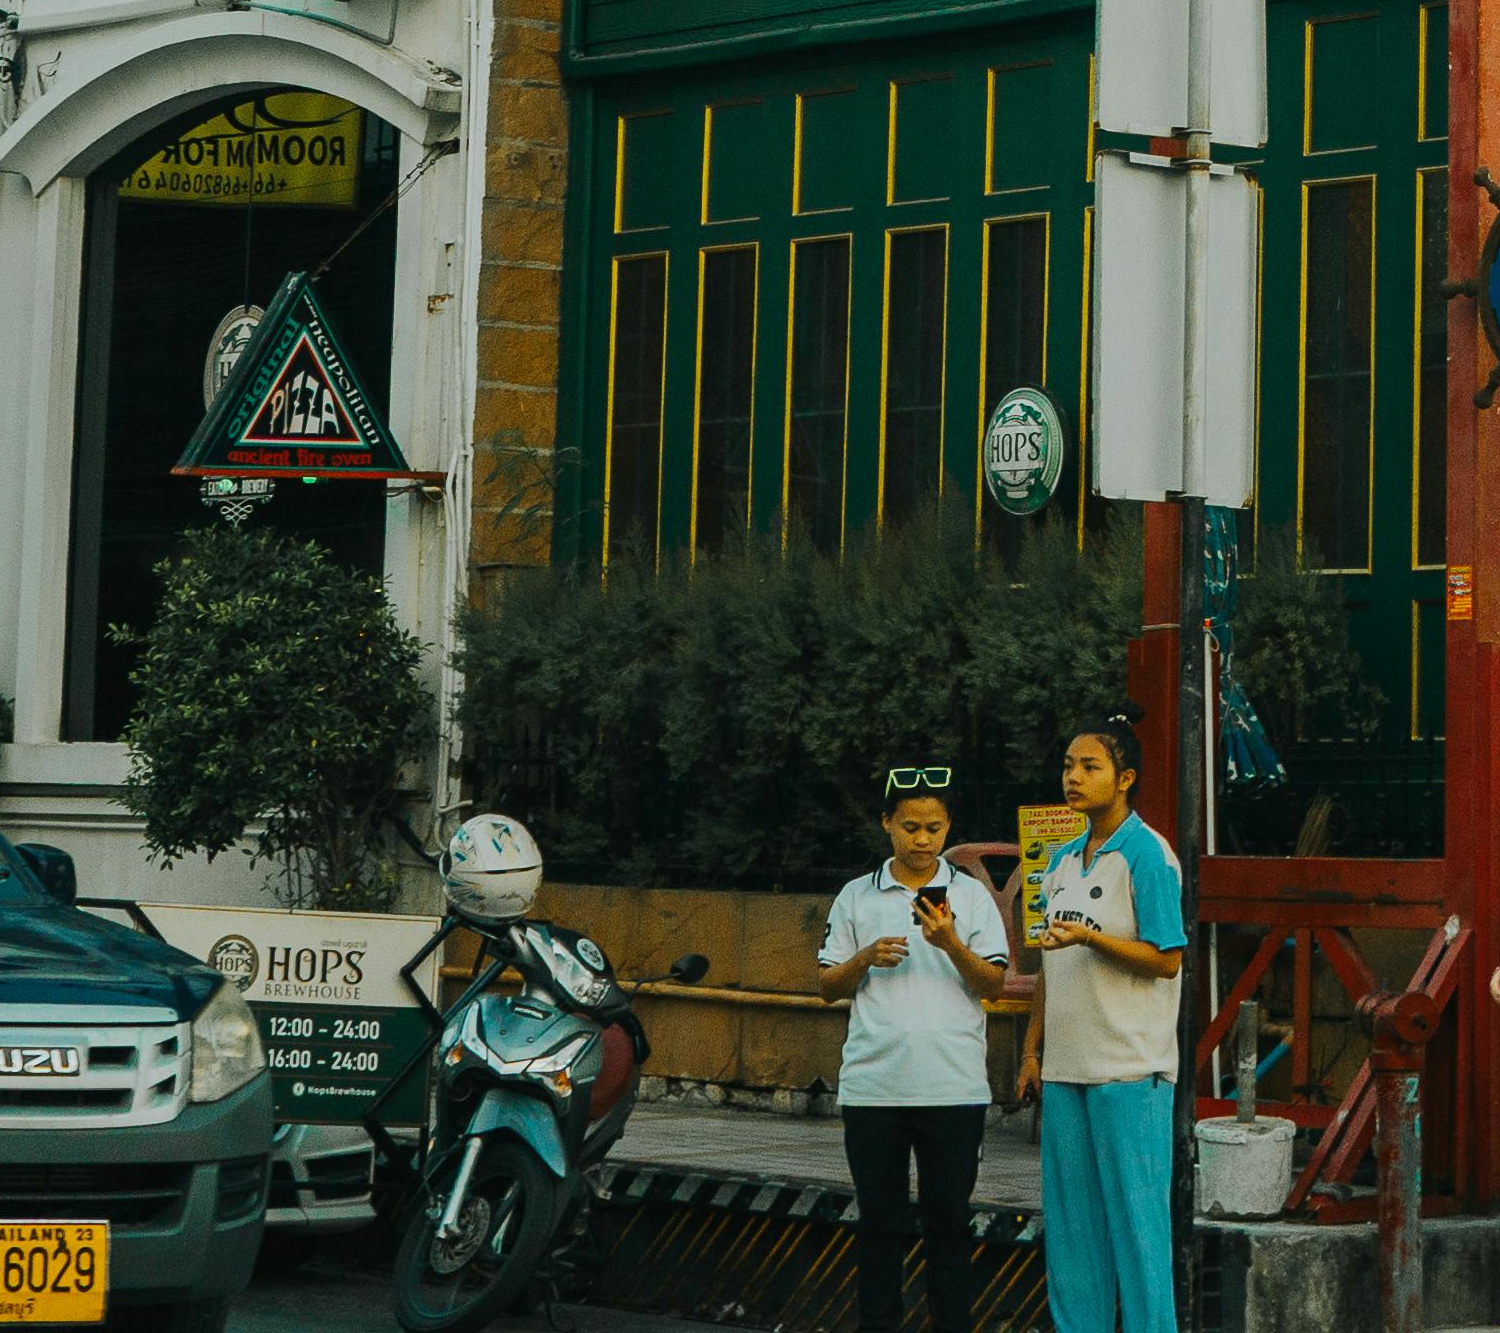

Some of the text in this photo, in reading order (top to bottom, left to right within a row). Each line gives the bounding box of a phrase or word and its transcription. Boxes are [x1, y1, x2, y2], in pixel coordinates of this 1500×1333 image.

[228, 315, 301, 439] original
[308, 319, 381, 445] neapolitan
[269, 371, 340, 434] PIZZA
[228, 449, 372, 467] ancient fire oven
[991, 431, 1042, 463] HOPS
[214, 955, 253, 974] HOPS
[266, 946, 367, 985] HOPS
[264, 984, 362, 1000] BREWHOUSE
[269, 1017, 313, 1037] 12:00
[333, 1019, 380, 1040] 24:00
[267, 1049, 311, 1068] 16:00
[330, 1052, 379, 1071] 24:00
[76, 1228, 93, 1241] 23
